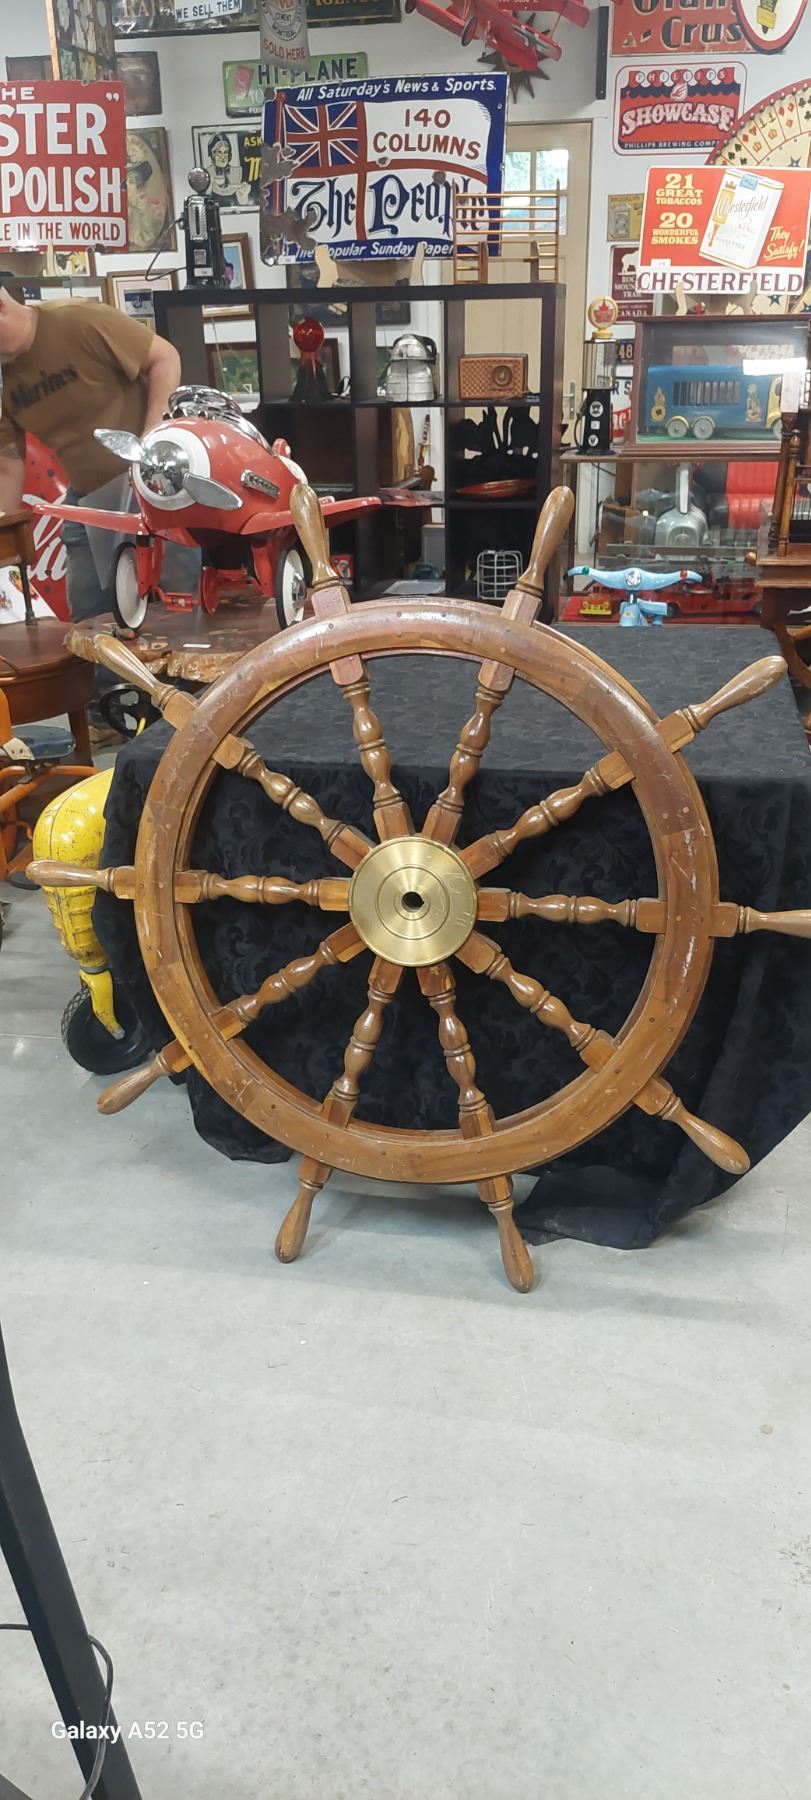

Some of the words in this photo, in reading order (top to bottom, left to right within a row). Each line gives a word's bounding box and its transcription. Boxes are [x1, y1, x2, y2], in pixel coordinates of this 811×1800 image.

[176, 7, 189, 20] WE
[193, 3, 214, 17] SELL
[217, 0, 241, 12] THEM
[661, 16, 750, 50] Crus
[263, 38, 285, 59] SOLD
[286, 47, 306, 61] HERE
[635, 69, 727, 84] PHILLIPS
[296, 87, 314, 101] All
[318, 80, 391, 100] Saturday's
[394, 80, 429, 93] News
[431, 82, 439, 92] &
[405, 108, 451, 129] 140
[621, 103, 736, 137] SHOWCASE
[372, 131, 482, 160] COLUMNS
[658, 141, 692, 149] BREWING
[694, 140, 720, 148] COMP
[0, 162, 122, 214] POLISH
[665, 173, 694, 189] 21
[656, 188, 703, 198] GREAT
[656, 197, 702, 206] TOBACCOS
[290, 178, 357, 239] The
[659, 212, 694, 228] 20
[17, 223, 31, 241] IN
[37, 222, 63, 240] THE
[69, 223, 120, 241] WORLD
[651, 236, 699, 245] SMOKES
[652, 228, 699, 236] WONDERFUL
[770, 226, 791, 243] They
[323, 245, 366, 258] opular
[370, 241, 414, 256] Sunday
